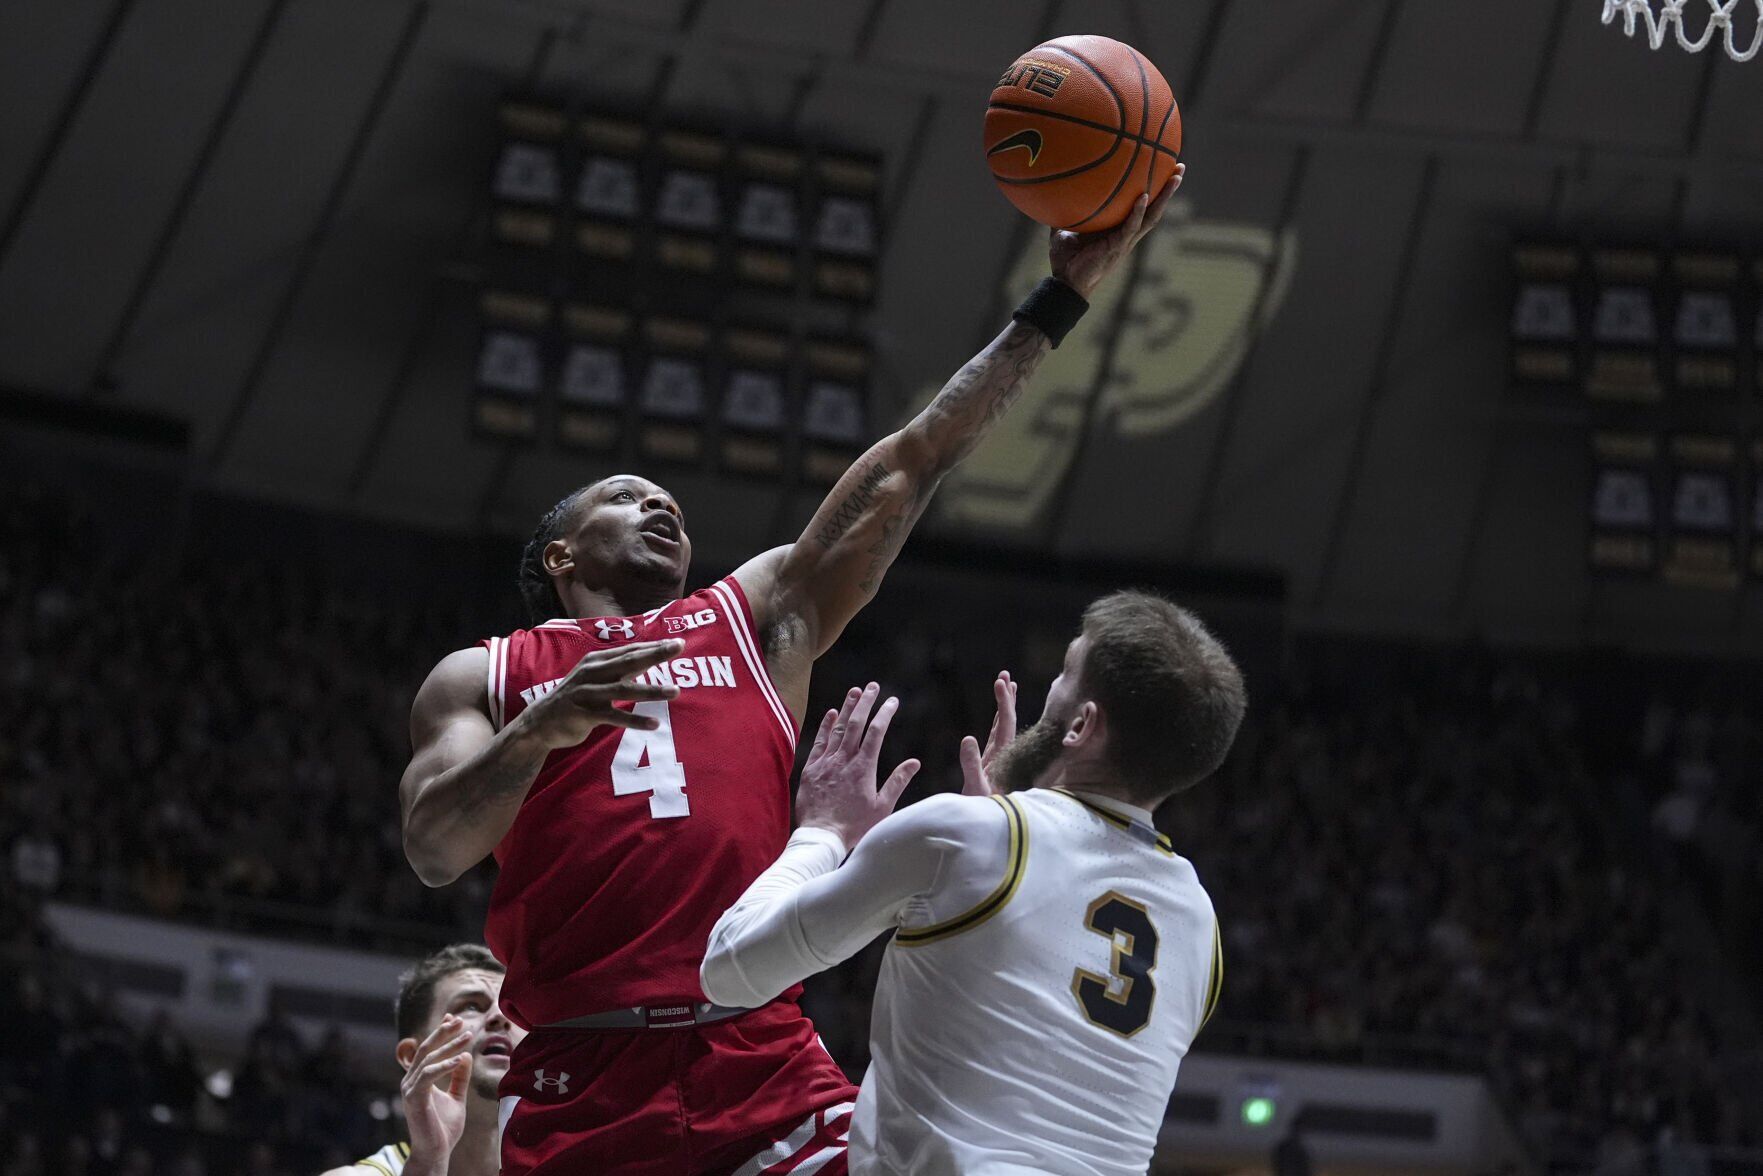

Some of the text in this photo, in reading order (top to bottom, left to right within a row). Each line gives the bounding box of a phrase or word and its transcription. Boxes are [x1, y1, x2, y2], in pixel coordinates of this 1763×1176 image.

[519, 655, 737, 707] WNSIN
[610, 700, 690, 819] 4
[1070, 889, 1160, 1039] 3
[649, 1006, 691, 1017] WISCONSIN
